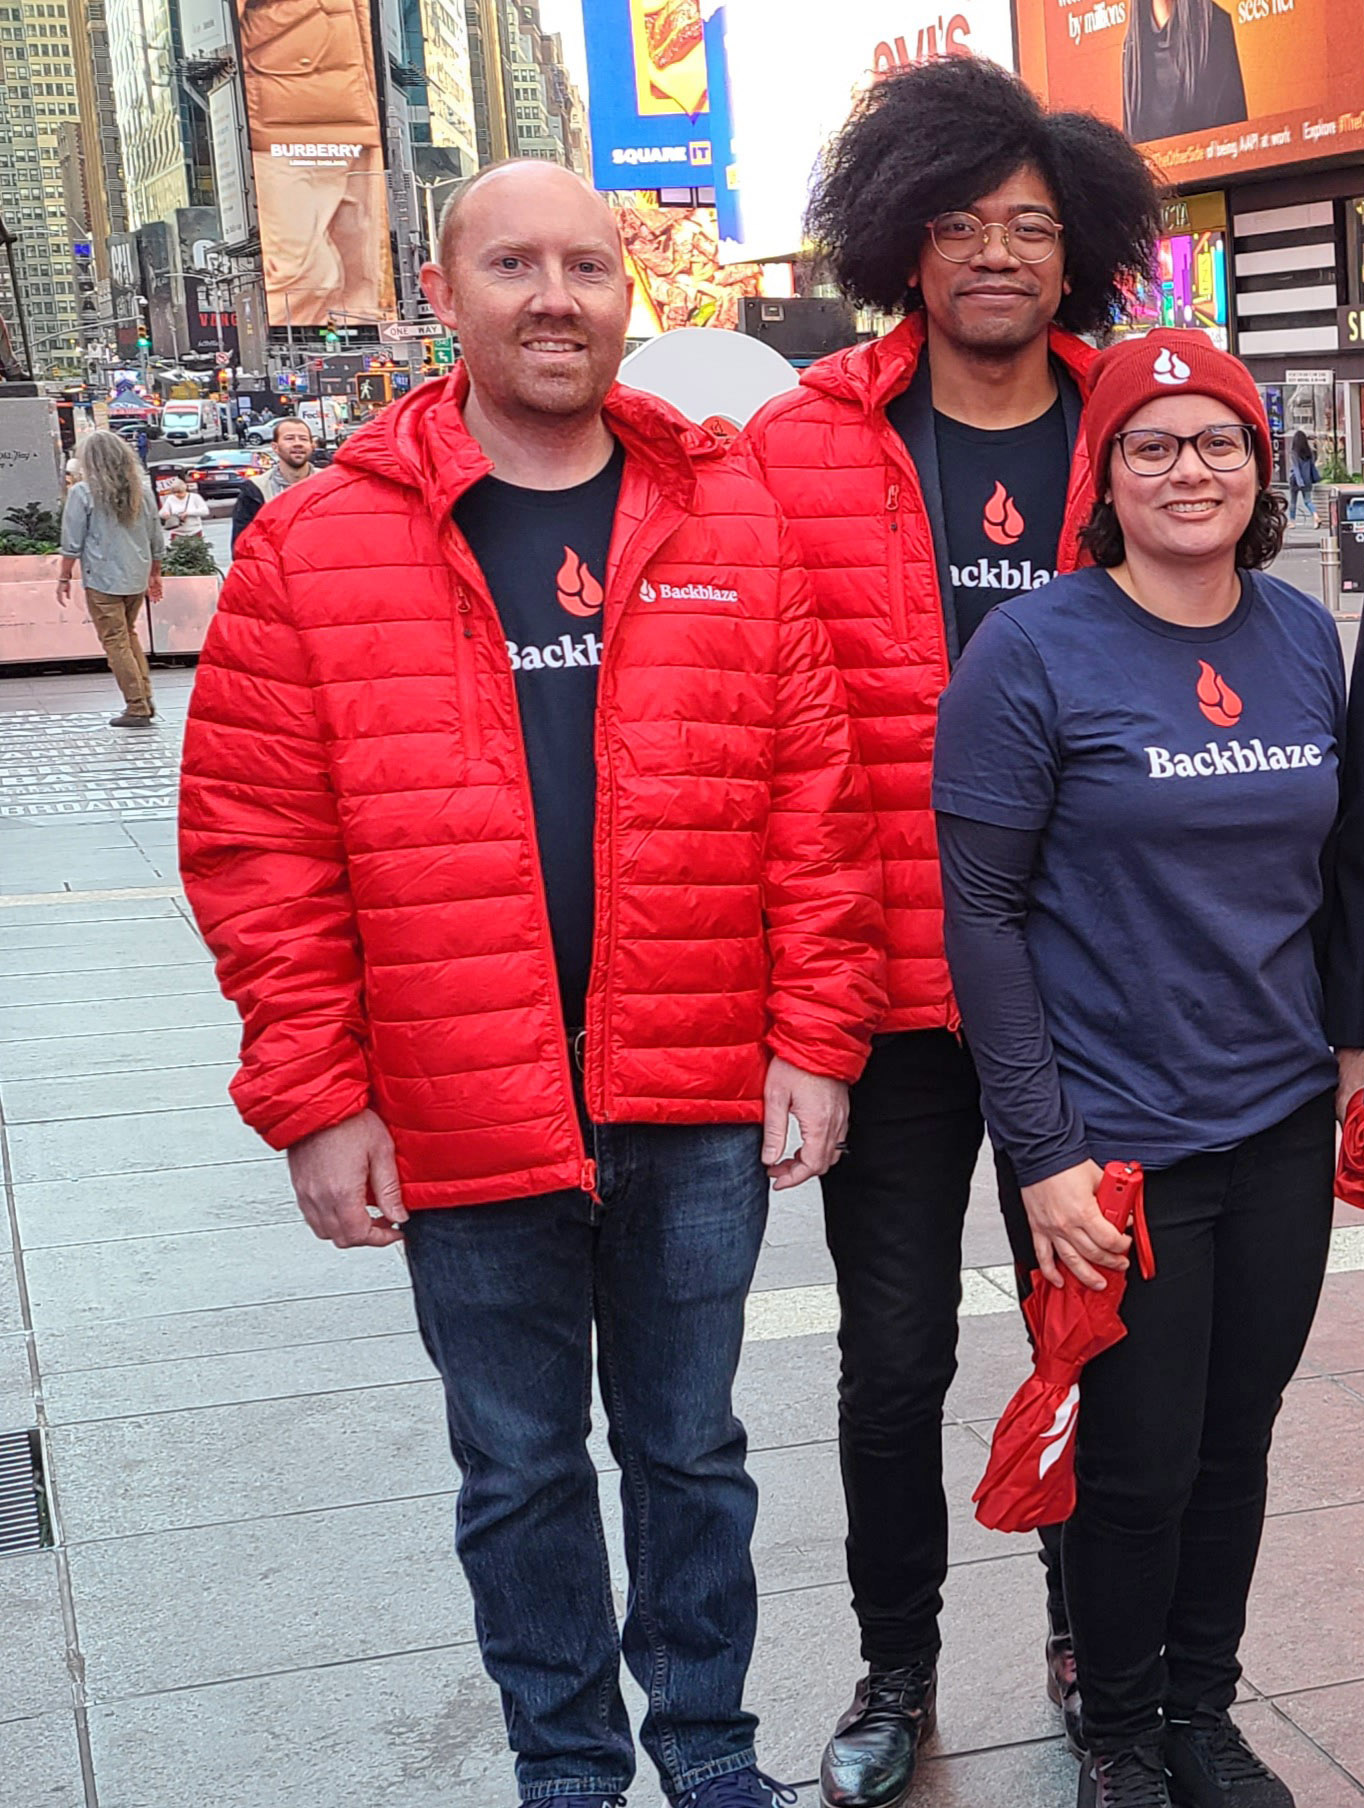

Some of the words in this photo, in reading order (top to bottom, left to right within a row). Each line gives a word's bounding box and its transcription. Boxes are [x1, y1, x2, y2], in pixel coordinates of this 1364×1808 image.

[1068, 11, 1082, 45] by
[1084, 1, 1126, 34] millions
[270, 143, 362, 158] BURBERRY
[611, 146, 687, 166] SQUARE
[692, 147, 708, 160] IT
[391, 327, 409, 336] ONE
[418, 326, 437, 334] WAY
[660, 584, 738, 603] Backblaze
[1143, 737, 1324, 780] Backblaze
